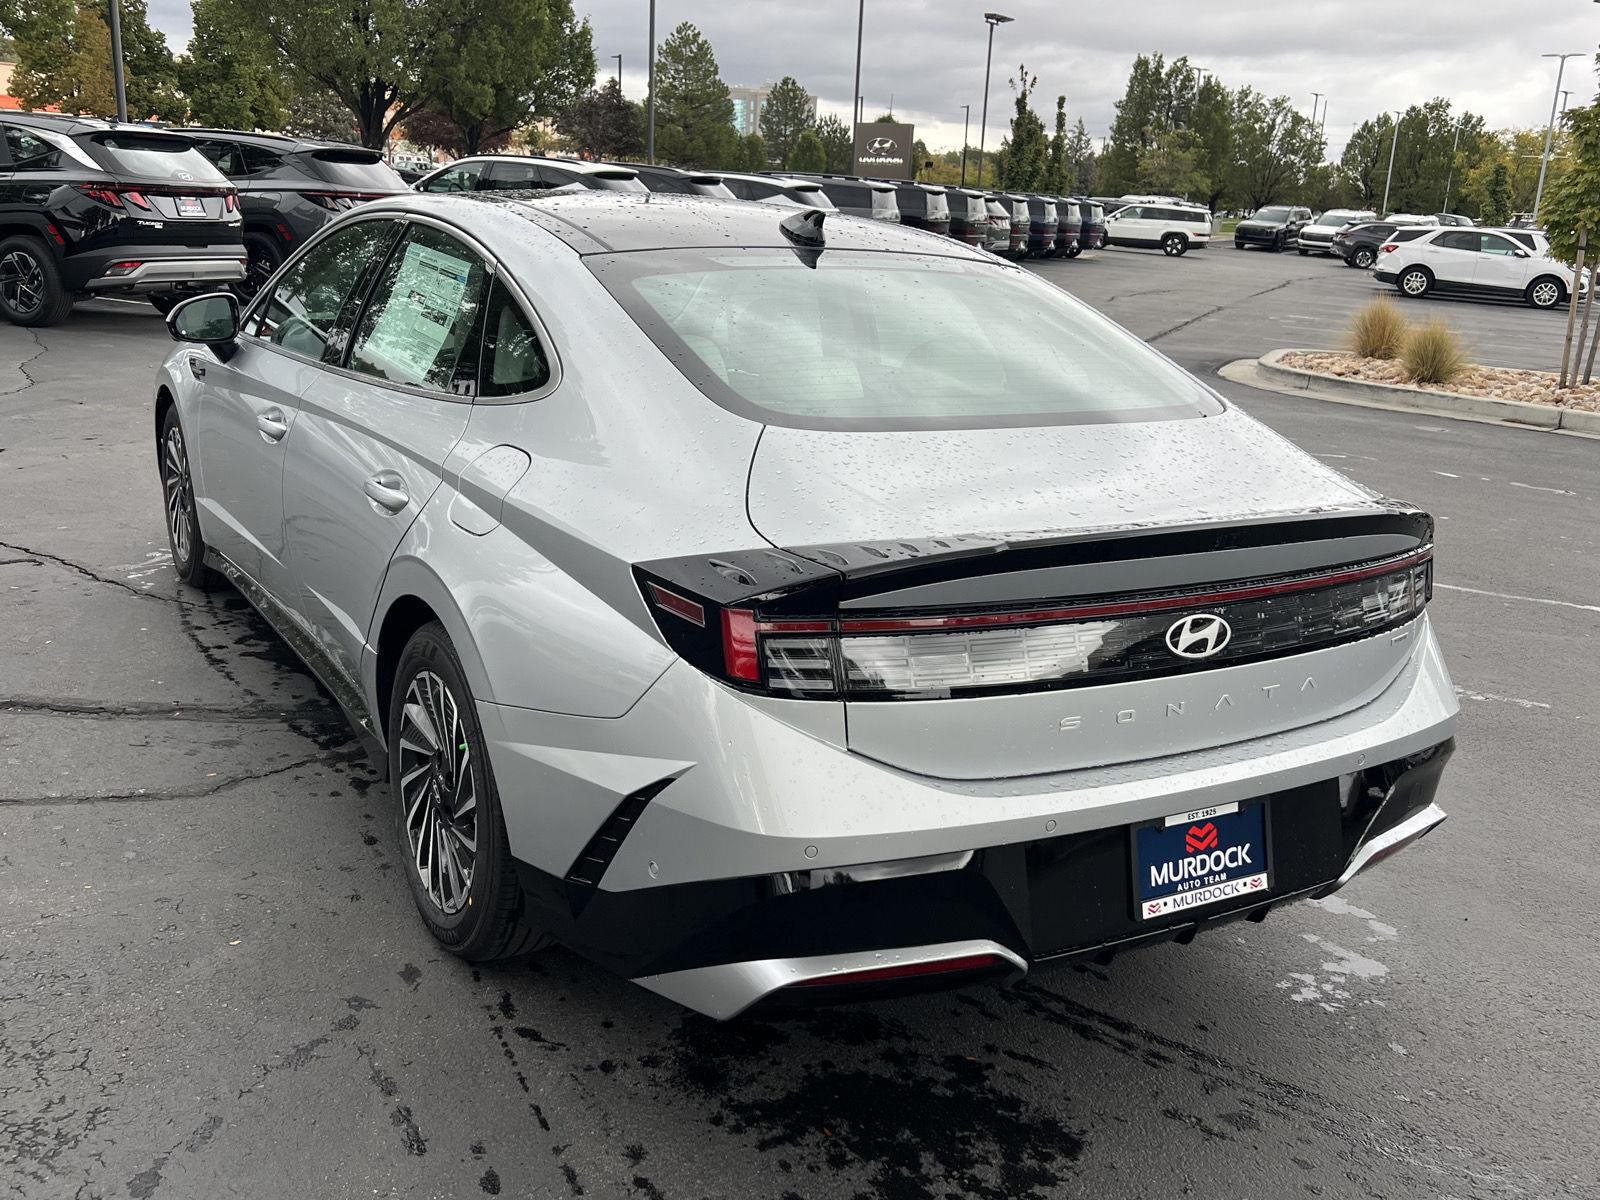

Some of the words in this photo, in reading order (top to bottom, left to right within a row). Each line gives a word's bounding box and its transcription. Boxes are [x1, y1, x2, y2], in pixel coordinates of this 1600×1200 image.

[1058, 676, 1319, 732] SONATA
[1187, 812, 1200, 821] EST.
[1201, 808, 1217, 818] 1925
[1150, 843, 1252, 887] MURDOCK
[1172, 882, 1241, 909] MURDOCK
[1177, 879, 1200, 892] AUTO
[1203, 872, 1227, 885] TEAM
